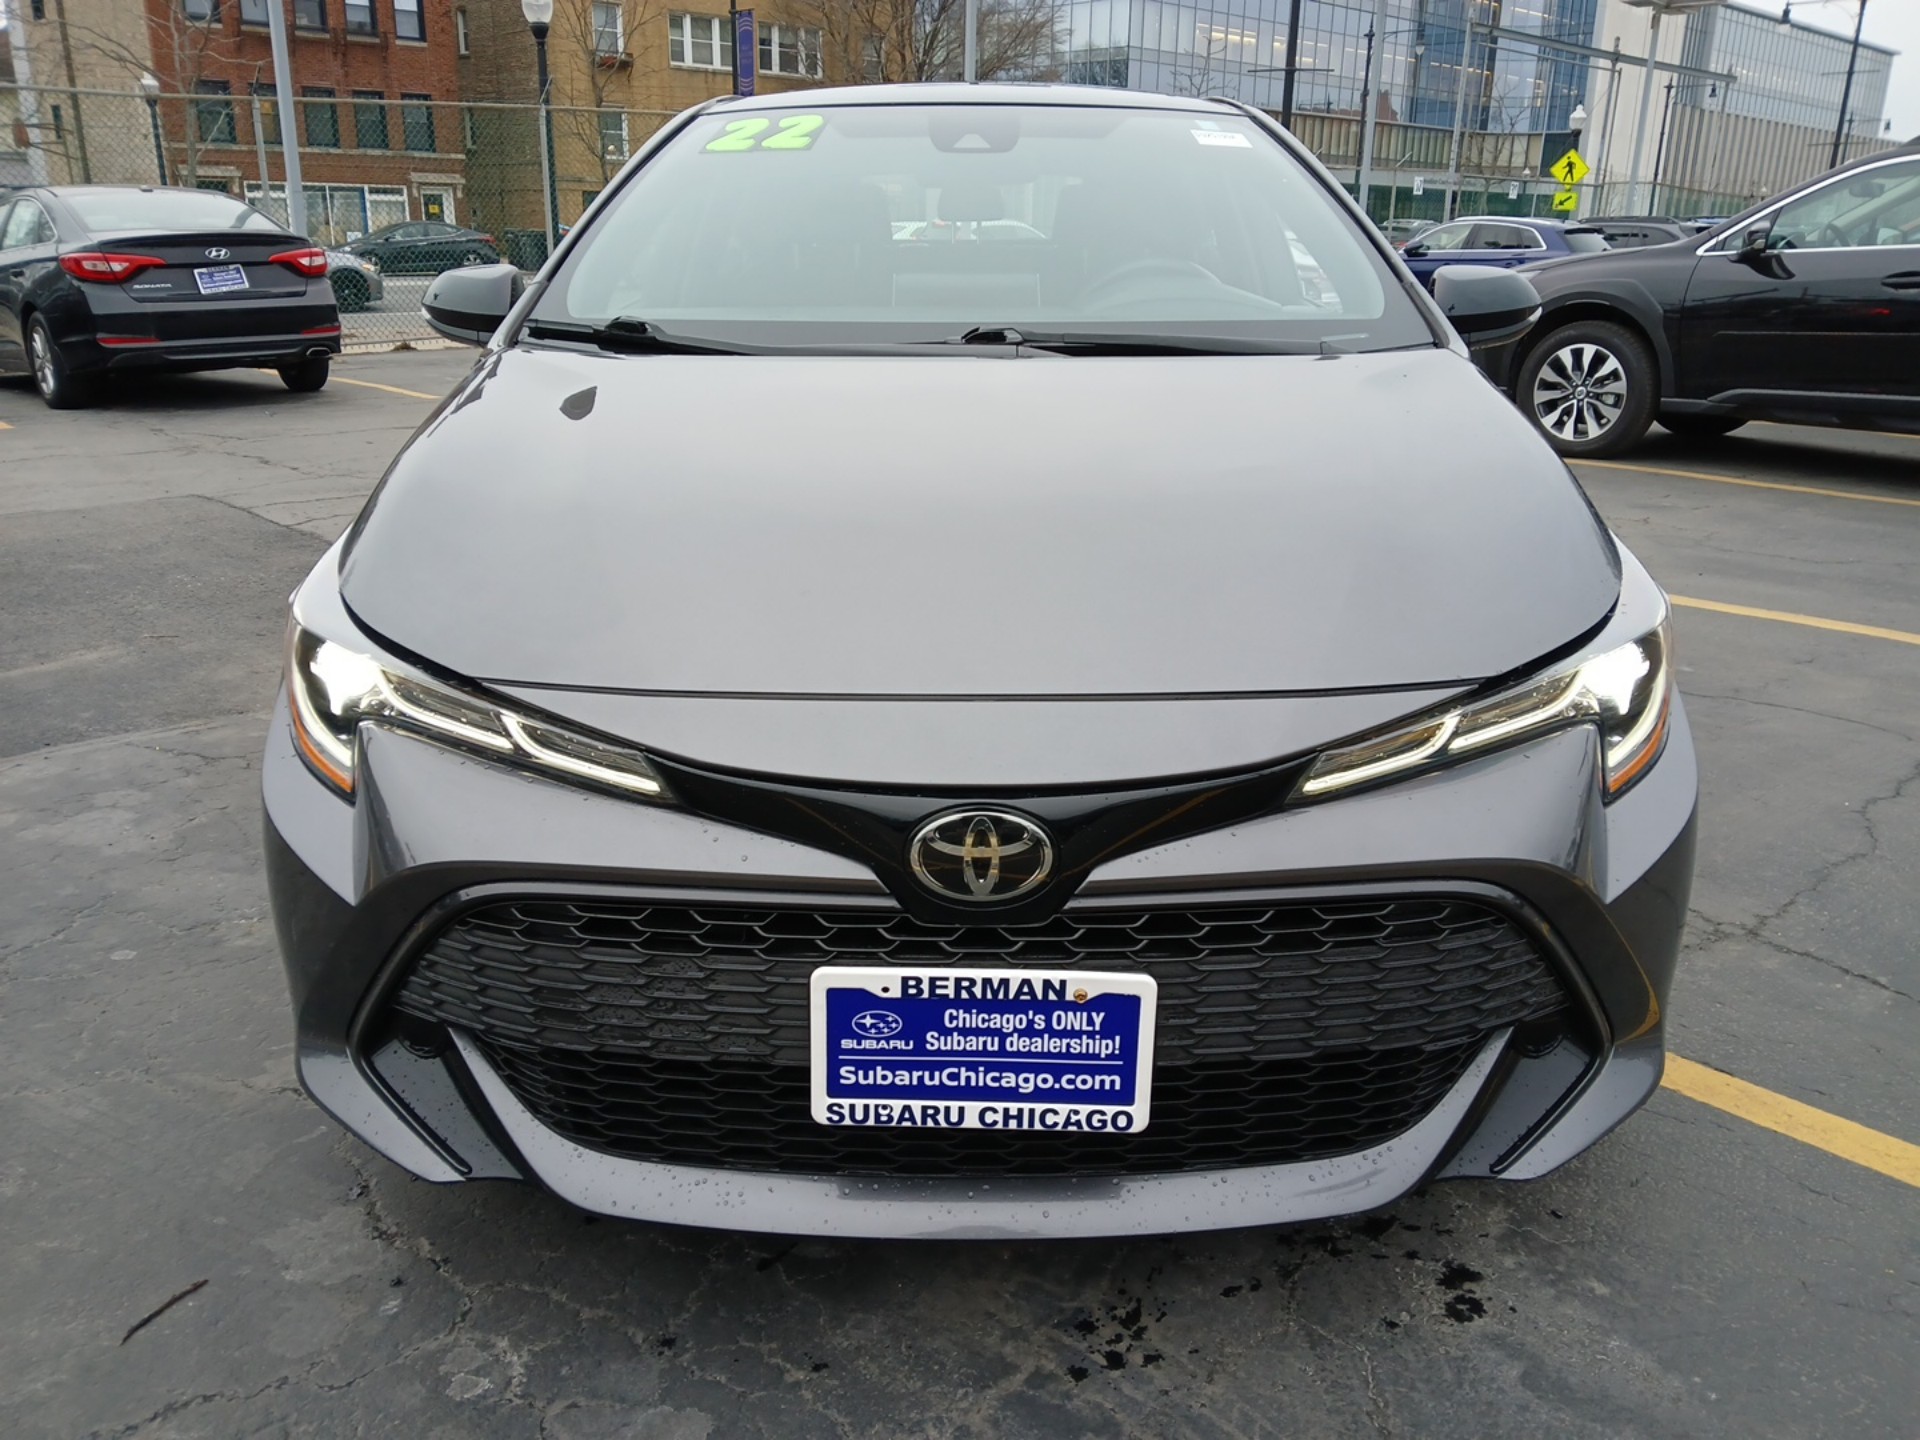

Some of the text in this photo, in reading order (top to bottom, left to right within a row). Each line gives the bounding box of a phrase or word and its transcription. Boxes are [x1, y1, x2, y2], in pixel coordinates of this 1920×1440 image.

[705, 115, 824, 151] 22
[901, 975, 1068, 1000] BERMAN
[944, 1009, 1105, 1032] Chicago's ONLY
[840, 1039, 914, 1050] SUBARU
[925, 1032, 1121, 1058] Subaru dealership!
[839, 1066, 1121, 1093] SubaruChicago.com
[825, 1102, 1134, 1132] SUBARU CHICAGO
